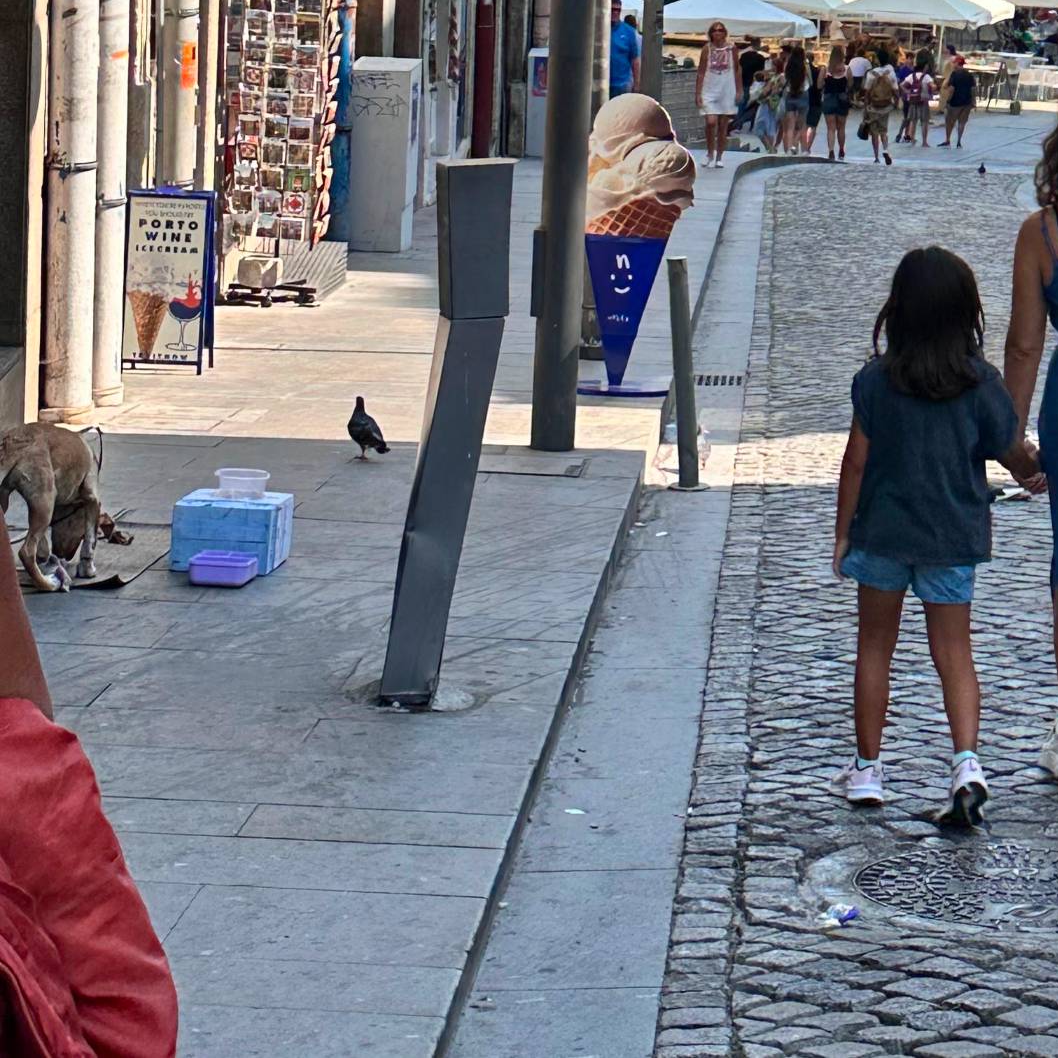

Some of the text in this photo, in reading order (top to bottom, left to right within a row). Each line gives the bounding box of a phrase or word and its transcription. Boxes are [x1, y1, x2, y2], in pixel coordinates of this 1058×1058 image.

[139, 218, 199, 231] PORTO
[145, 231, 192, 243] WINE
[616, 254, 630, 269] n
